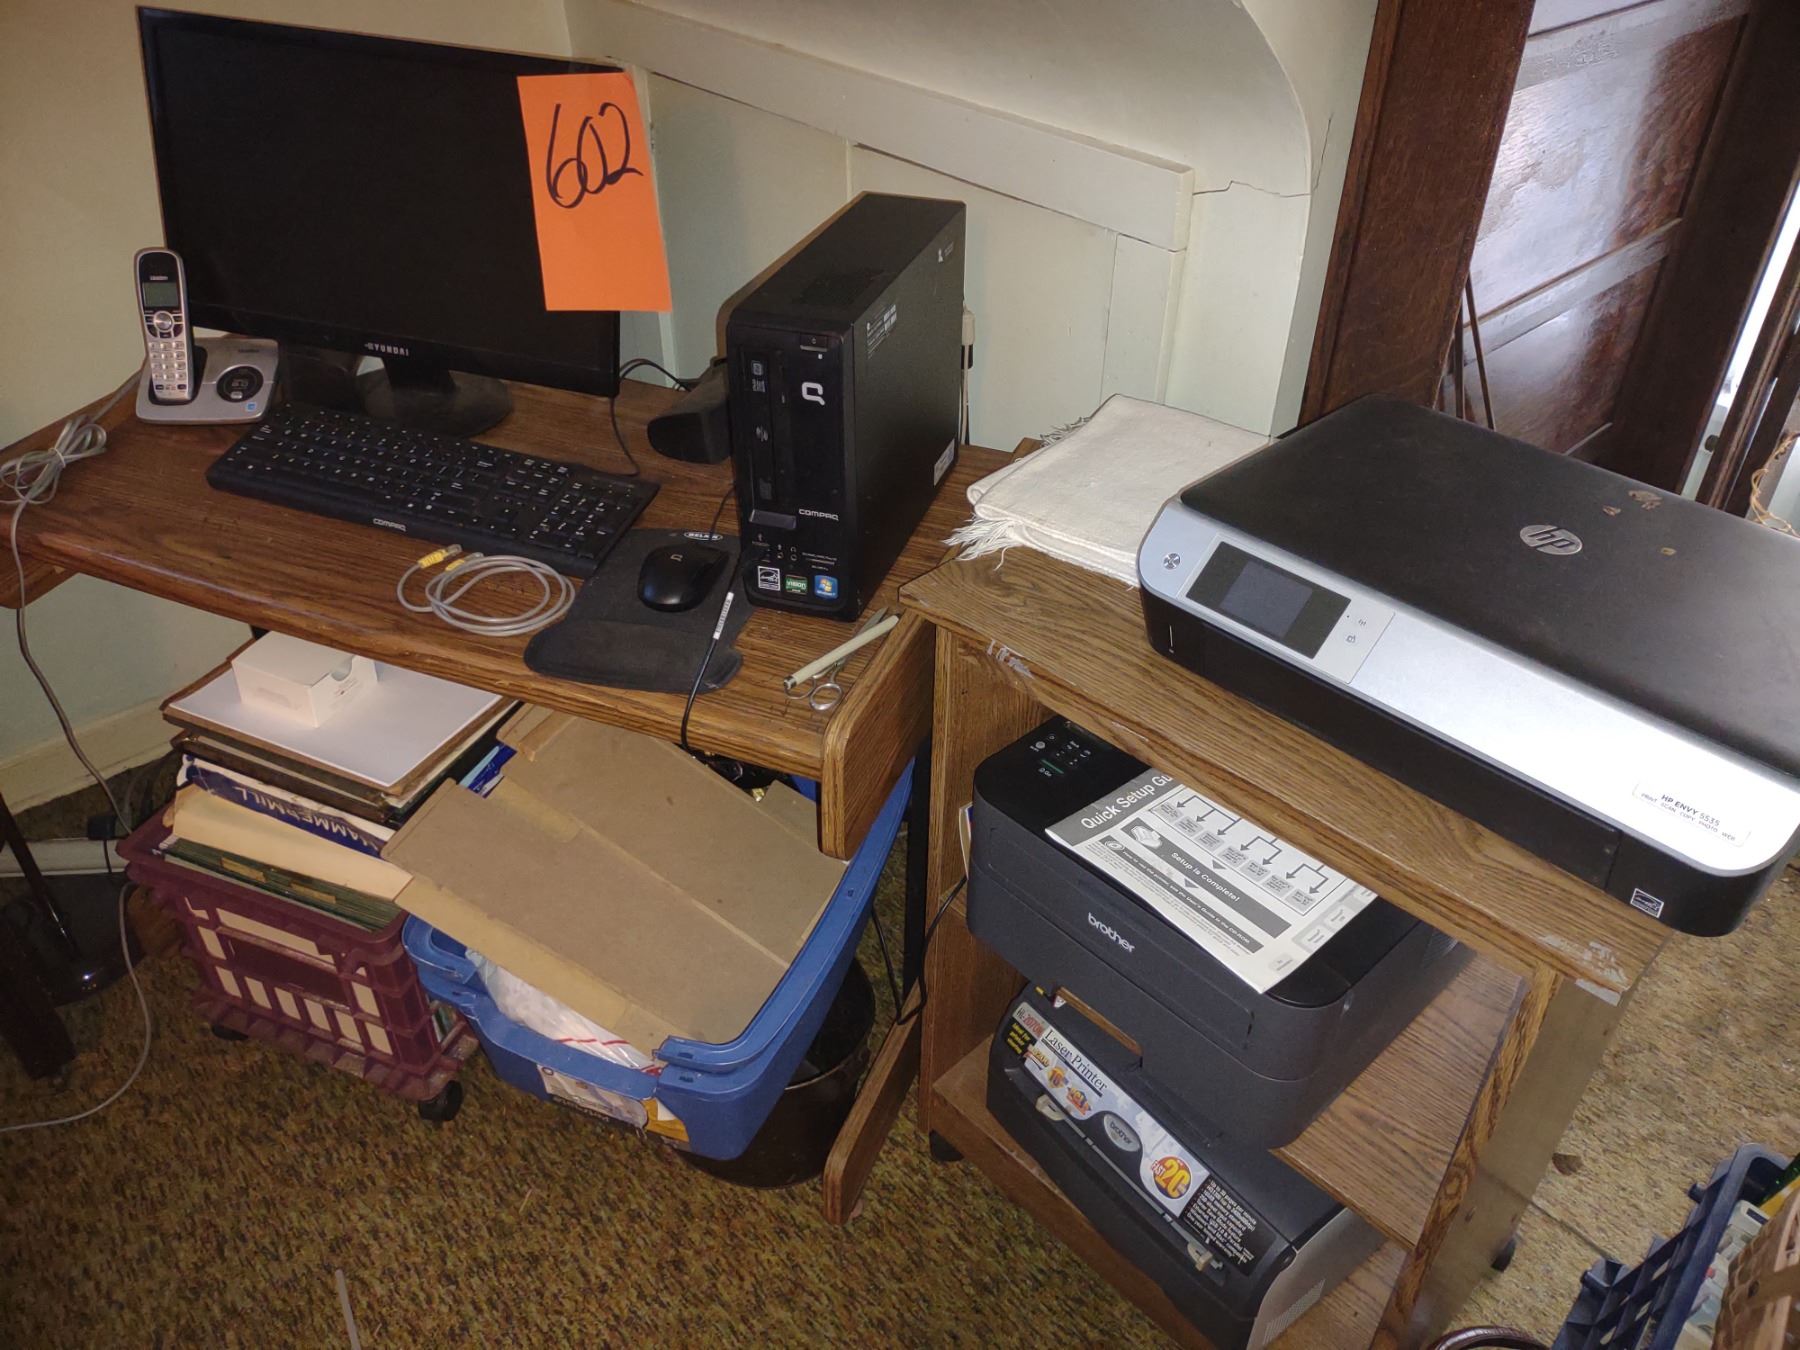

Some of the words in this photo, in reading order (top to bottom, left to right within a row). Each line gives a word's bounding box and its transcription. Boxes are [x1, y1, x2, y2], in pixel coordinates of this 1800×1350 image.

[546, 102, 643, 208] 602
[799, 508, 839, 521] COMPAQ
[1081, 805, 1122, 829] Quick
[1116, 784, 1156, 808] Setup
[1661, 794, 1674, 803] HP
[1674, 801, 1698, 815] ENVY
[1171, 851, 1193, 870] Setup
[1201, 873, 1240, 903] Complete!
[1088, 912, 1135, 952] brother
[1044, 1029, 1073, 1058] Laser
[1071, 1054, 1108, 1091] Printer
[1110, 1121, 1132, 1144] brother
[1151, 1160, 1166, 1177] FAST
